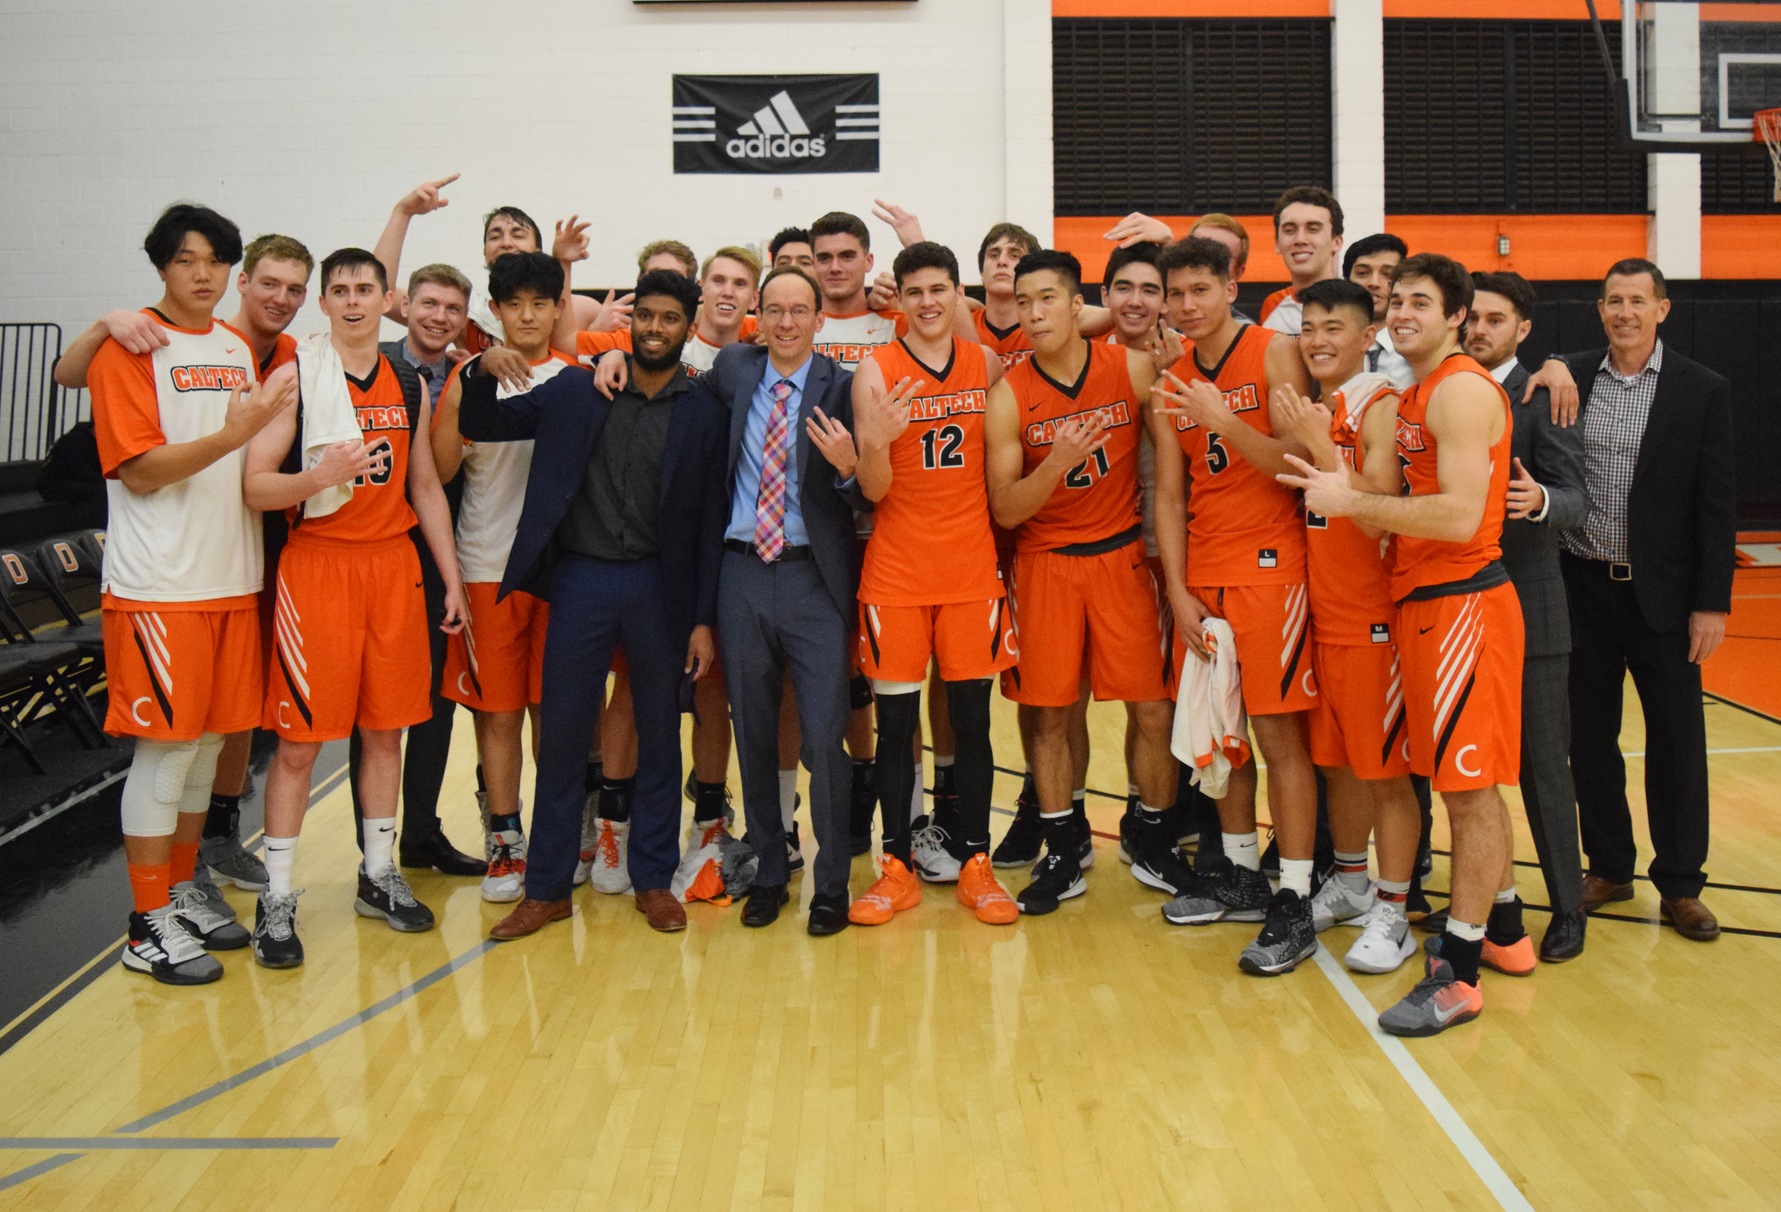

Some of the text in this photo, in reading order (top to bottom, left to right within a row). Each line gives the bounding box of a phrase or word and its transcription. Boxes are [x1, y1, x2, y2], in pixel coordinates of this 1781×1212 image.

[726, 133, 826, 158] adidas
[354, 406, 410, 431] TECH
[894, 388, 987, 422] ALTECH
[920, 424, 965, 470] 12
[1205, 431, 1229, 475] 5
[1264, 550, 1270, 558] L
[1455, 744, 1481, 777] C
